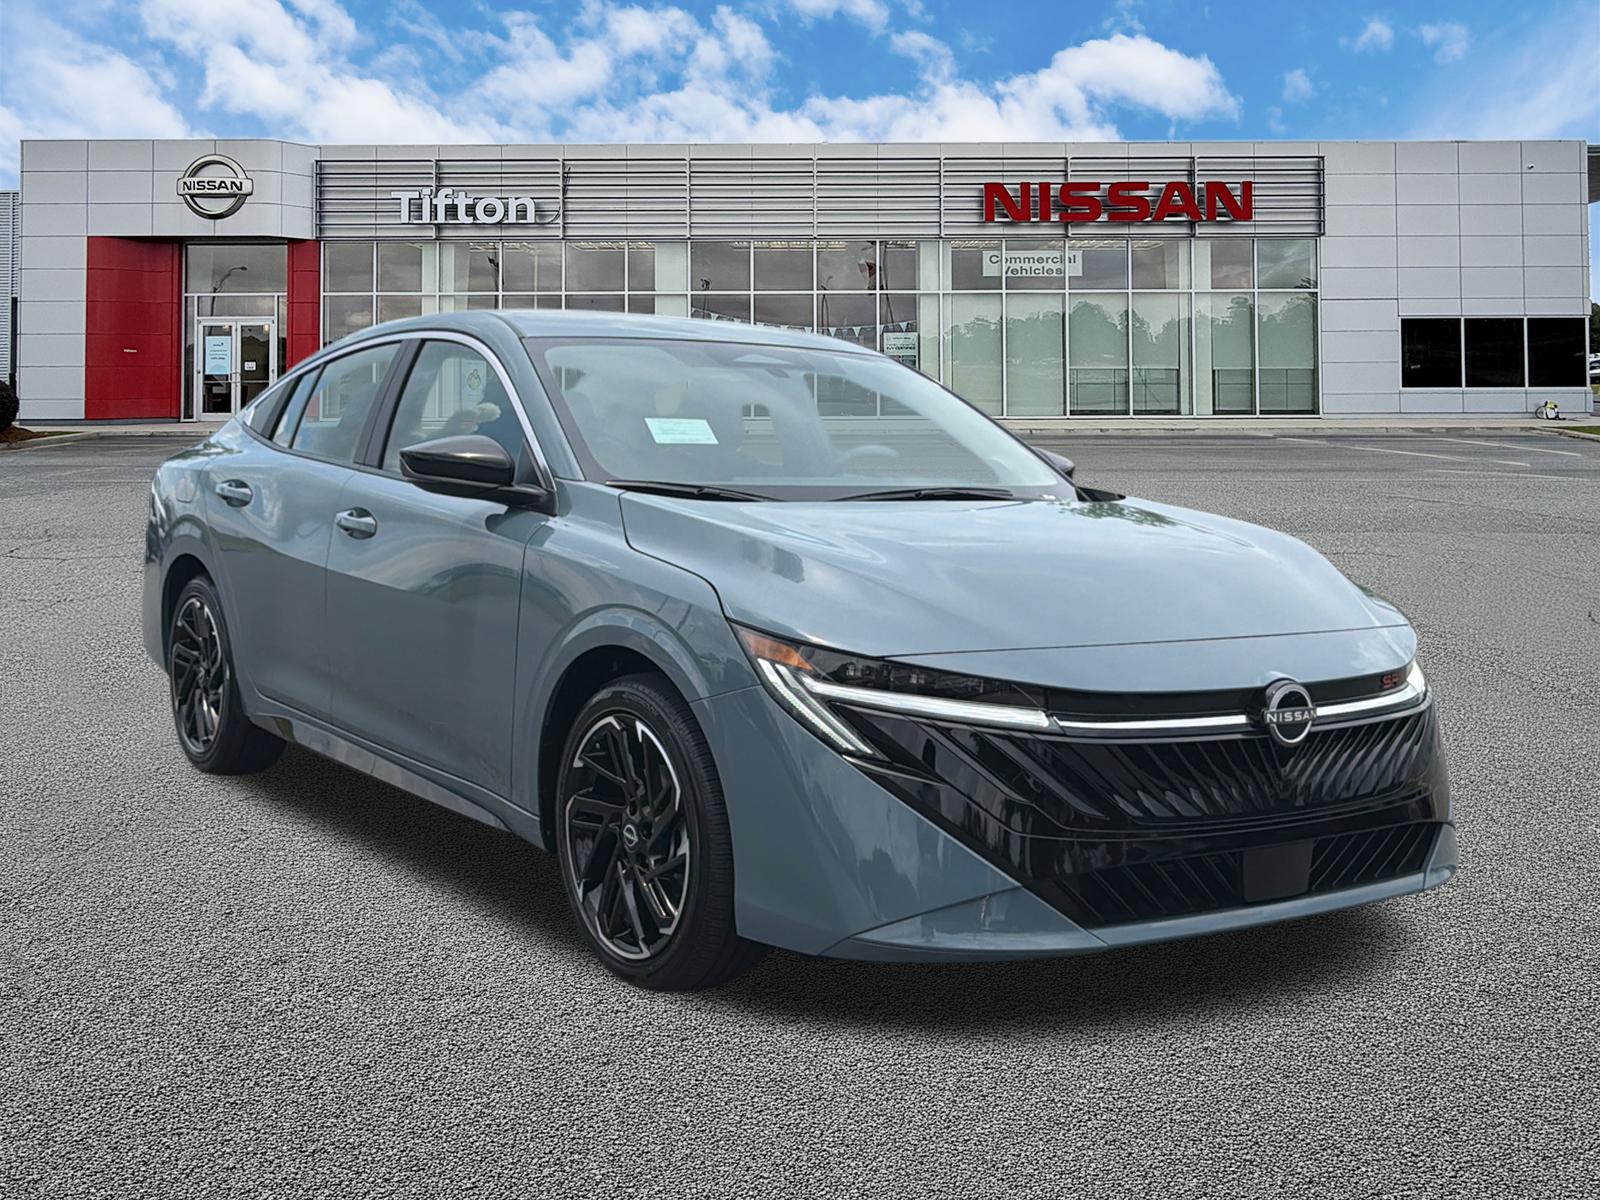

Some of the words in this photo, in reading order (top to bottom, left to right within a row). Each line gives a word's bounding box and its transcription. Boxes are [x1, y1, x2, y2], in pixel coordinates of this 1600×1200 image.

[183, 181, 243, 191] NISSAN
[391, 187, 536, 223] Tifton
[983, 181, 1253, 222] NISSAN
[1266, 710, 1317, 723] NISSAN
